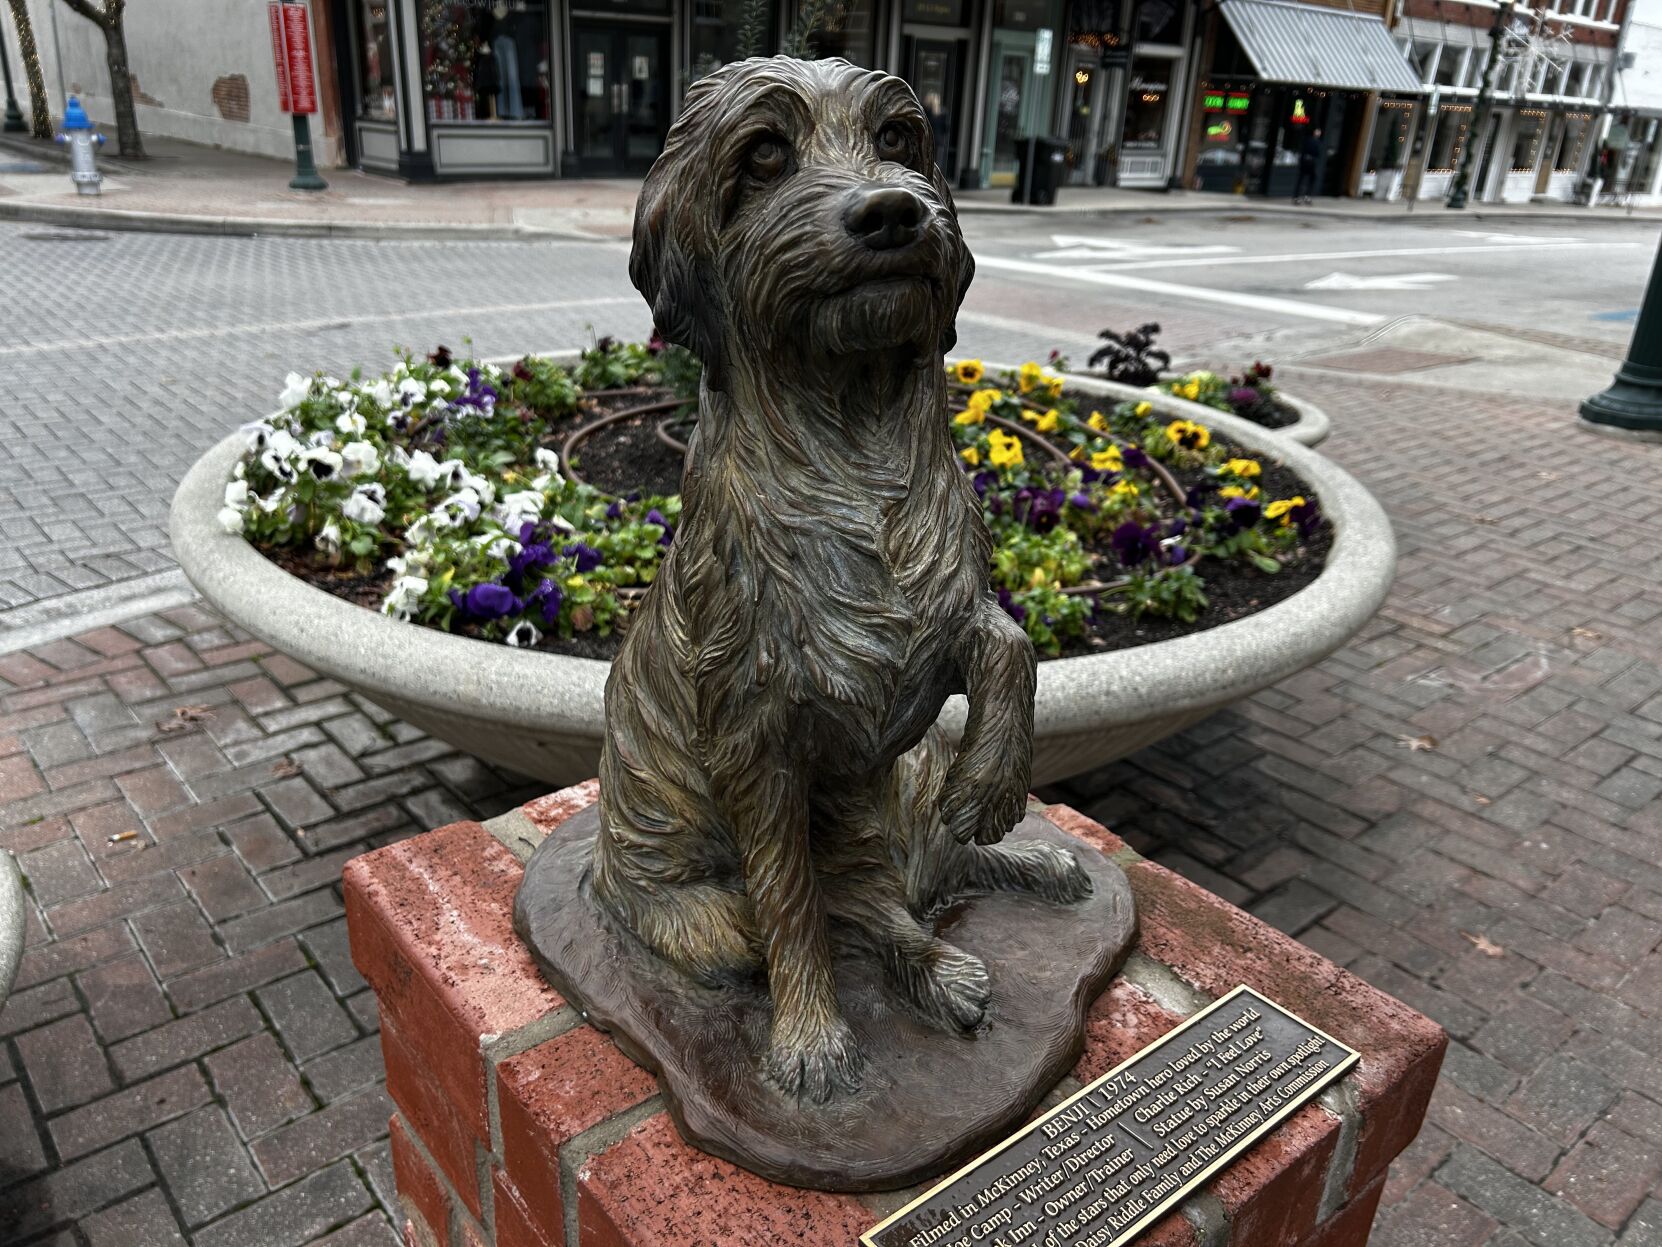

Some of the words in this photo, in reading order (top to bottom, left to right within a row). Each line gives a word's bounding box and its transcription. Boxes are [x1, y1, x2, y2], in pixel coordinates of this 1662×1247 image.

[910, 1212, 961, 1247] Filmed
[958, 1206, 978, 1218] in
[977, 1157, 1047, 1208] McKinney,
[1042, 1132, 1080, 1160] Texas
[1086, 1085, 1150, 1129] Hometown
[1144, 1068, 1173, 1090] hero
[1168, 1047, 1201, 1072] loved
[1198, 1038, 1216, 1055] by
[1212, 1028, 1232, 1046] the
[1230, 1008, 1261, 1031] world
[1042, 1102, 1090, 1139] BENJI
[1098, 1071, 1137, 1100] 1974
[1134, 1090, 1177, 1123] Charlie
[1172, 1073, 1202, 1096] Rich
[1217, 1044, 1239, 1066] Feel
[1154, 1106, 1194, 1137] Statue
[1187, 1096, 1208, 1110] by
[1204, 1076, 1240, 1100] Susan
[1234, 1050, 1271, 1078] Norris
[946, 1236, 972, 1247] oe
[970, 1207, 1012, 1240] Camp
[1018, 1134, 1116, 1204] Writer/Director
[1046, 1230, 1062, 1247] of
[1056, 1219, 1080, 1238] the
[1078, 1198, 1108, 1224] stars
[1104, 1180, 1132, 1202] that
[1130, 1163, 1155, 1185] only
[1152, 1144, 1178, 1167] need
[1171, 1131, 1197, 1150] love
[1192, 1122, 1208, 1135] to
[1206, 1097, 1240, 1129] sparkle
[1234, 1089, 1251, 1102] in
[1246, 1071, 1271, 1095] their
[1270, 1061, 1291, 1080] own
[1288, 1036, 1326, 1068] spotlight
[1107, 1198, 1147, 1230] Riddle
[1141, 1172, 1183, 1204] Family
[1180, 1155, 1203, 1176] and
[1195, 1142, 1219, 1161] The
[1216, 1110, 1265, 1147] McKinney
[1258, 1095, 1280, 1116] Arts
[1276, 1059, 1330, 1100] Commission
[1008, 1220, 1037, 1243] Inn
[1044, 1148, 1134, 1216] Owner/Trainer
